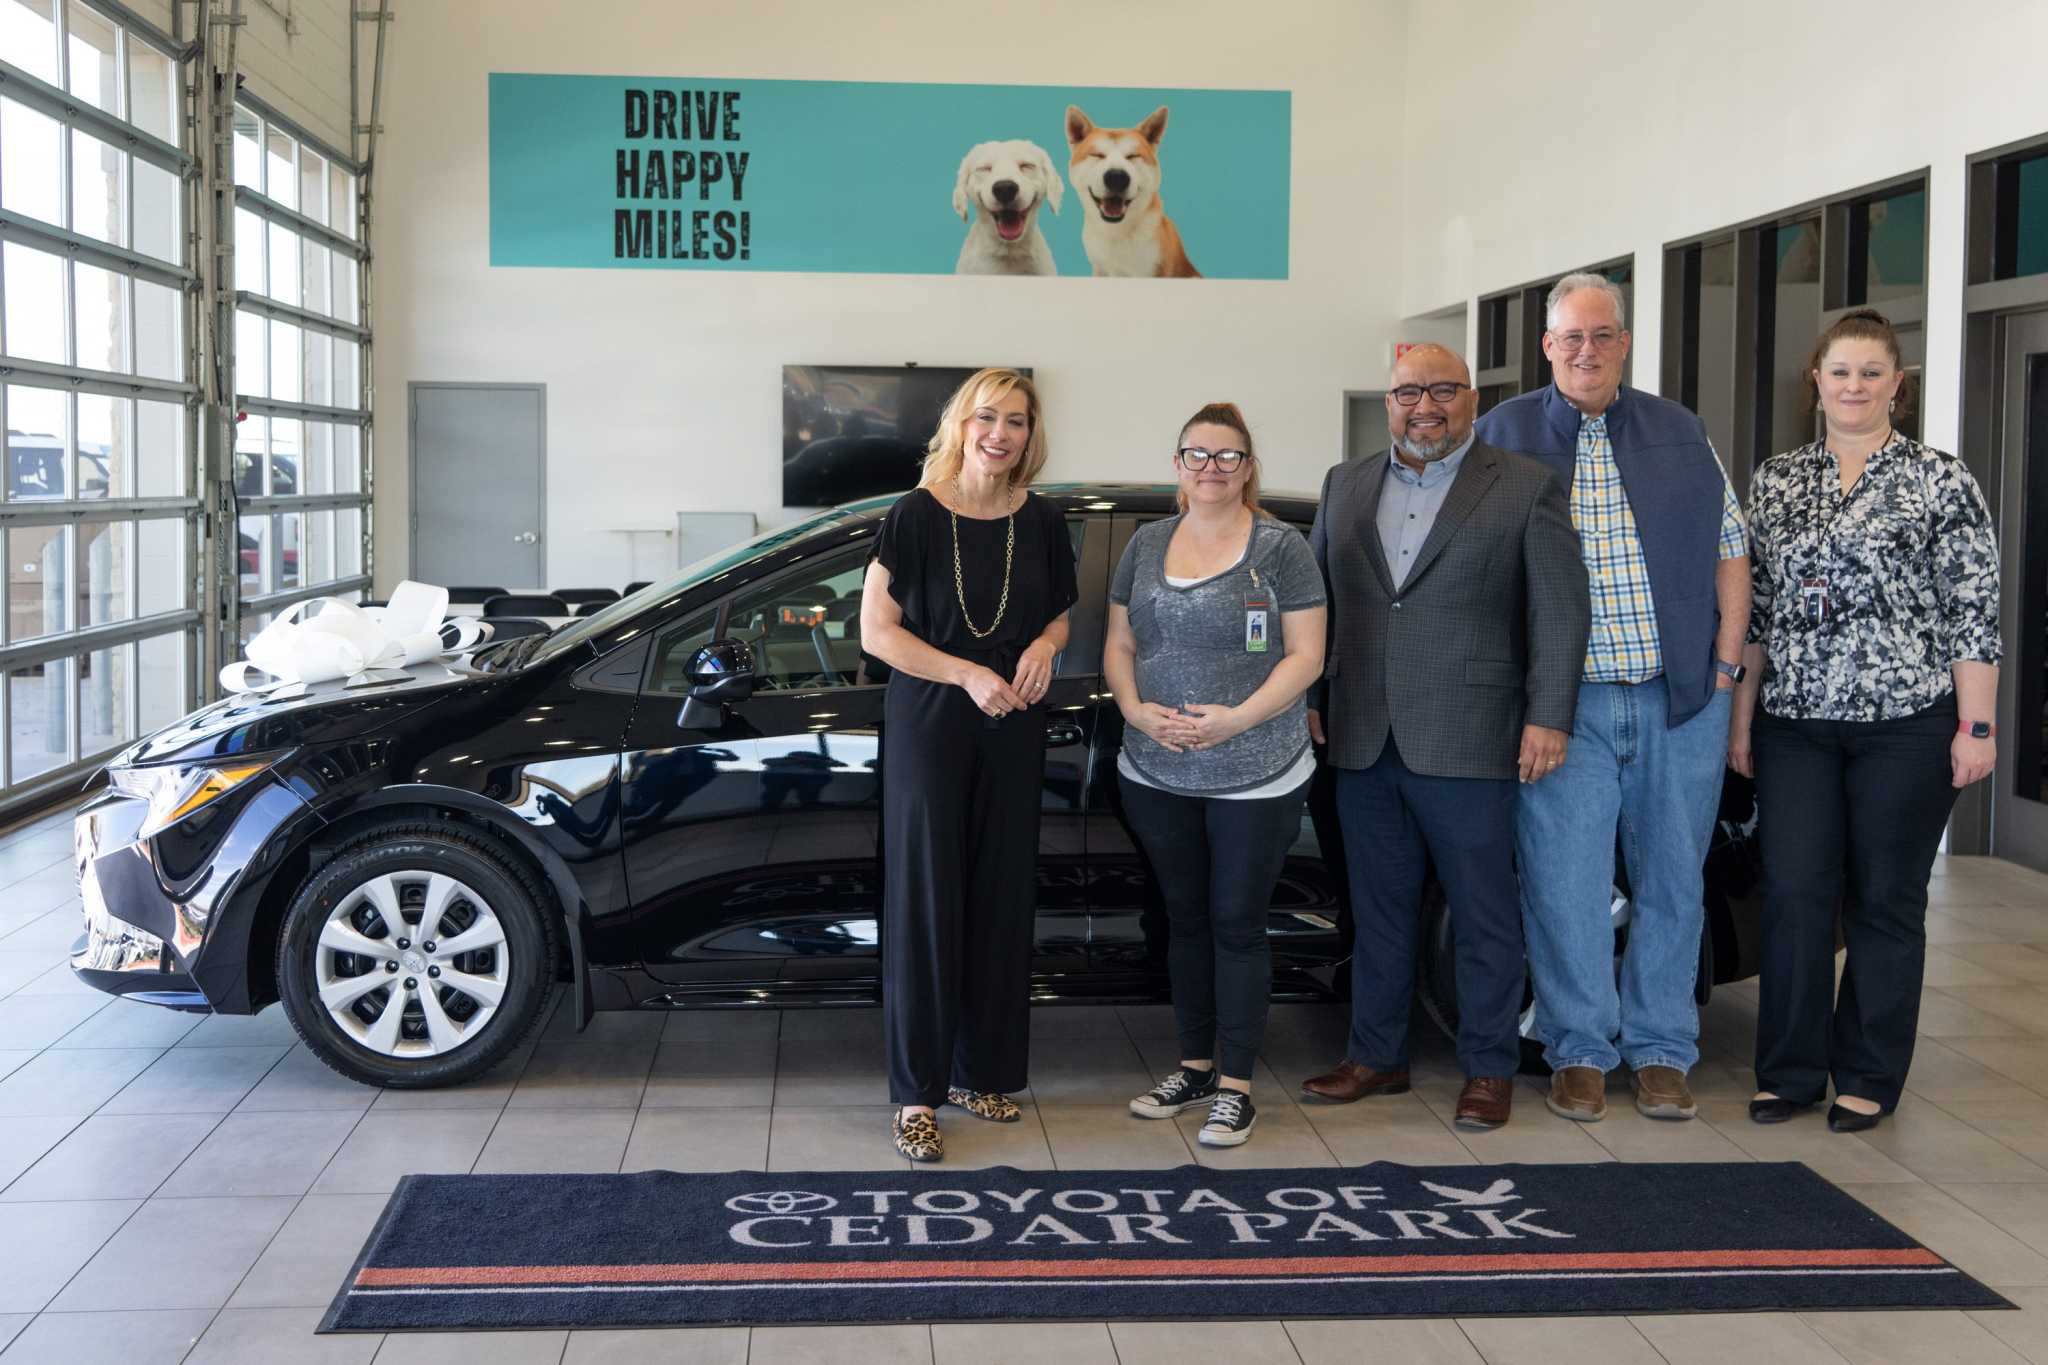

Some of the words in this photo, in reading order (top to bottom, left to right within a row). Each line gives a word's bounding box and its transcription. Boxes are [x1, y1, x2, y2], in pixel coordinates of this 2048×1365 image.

[624, 89, 741, 141] DRIVE
[616, 149, 750, 201] HAPPY
[614, 209, 750, 261] MILES!
[852, 1189, 1247, 1213] TOYOTA
[1265, 1186, 1387, 1211] OF
[728, 1213, 1193, 1247] CEDAR
[1216, 1208, 1577, 1244] PARK
